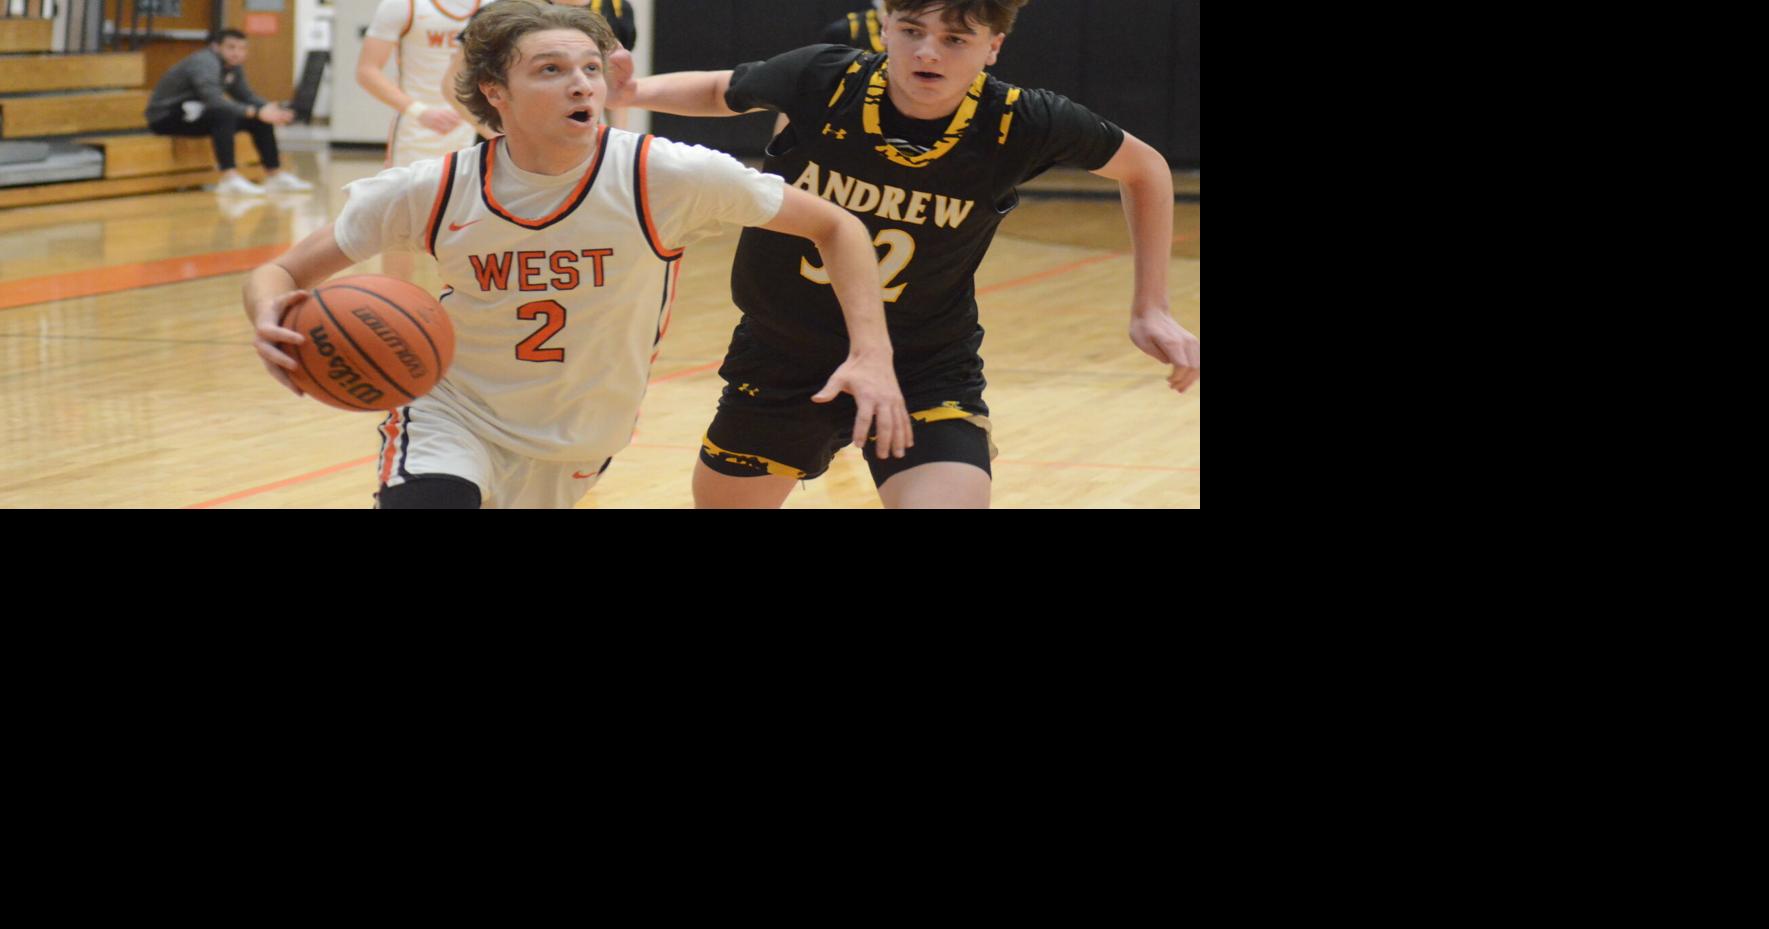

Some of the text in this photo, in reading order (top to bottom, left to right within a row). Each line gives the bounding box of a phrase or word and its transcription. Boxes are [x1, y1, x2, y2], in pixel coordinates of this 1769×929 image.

[426, 29, 458, 48] WE
[791, 160, 975, 229] ANDREW
[468, 248, 614, 292] WEST
[308, 324, 384, 404] Wilson
[351, 305, 428, 379] EVOLUTION
[515, 299, 567, 363] 2
